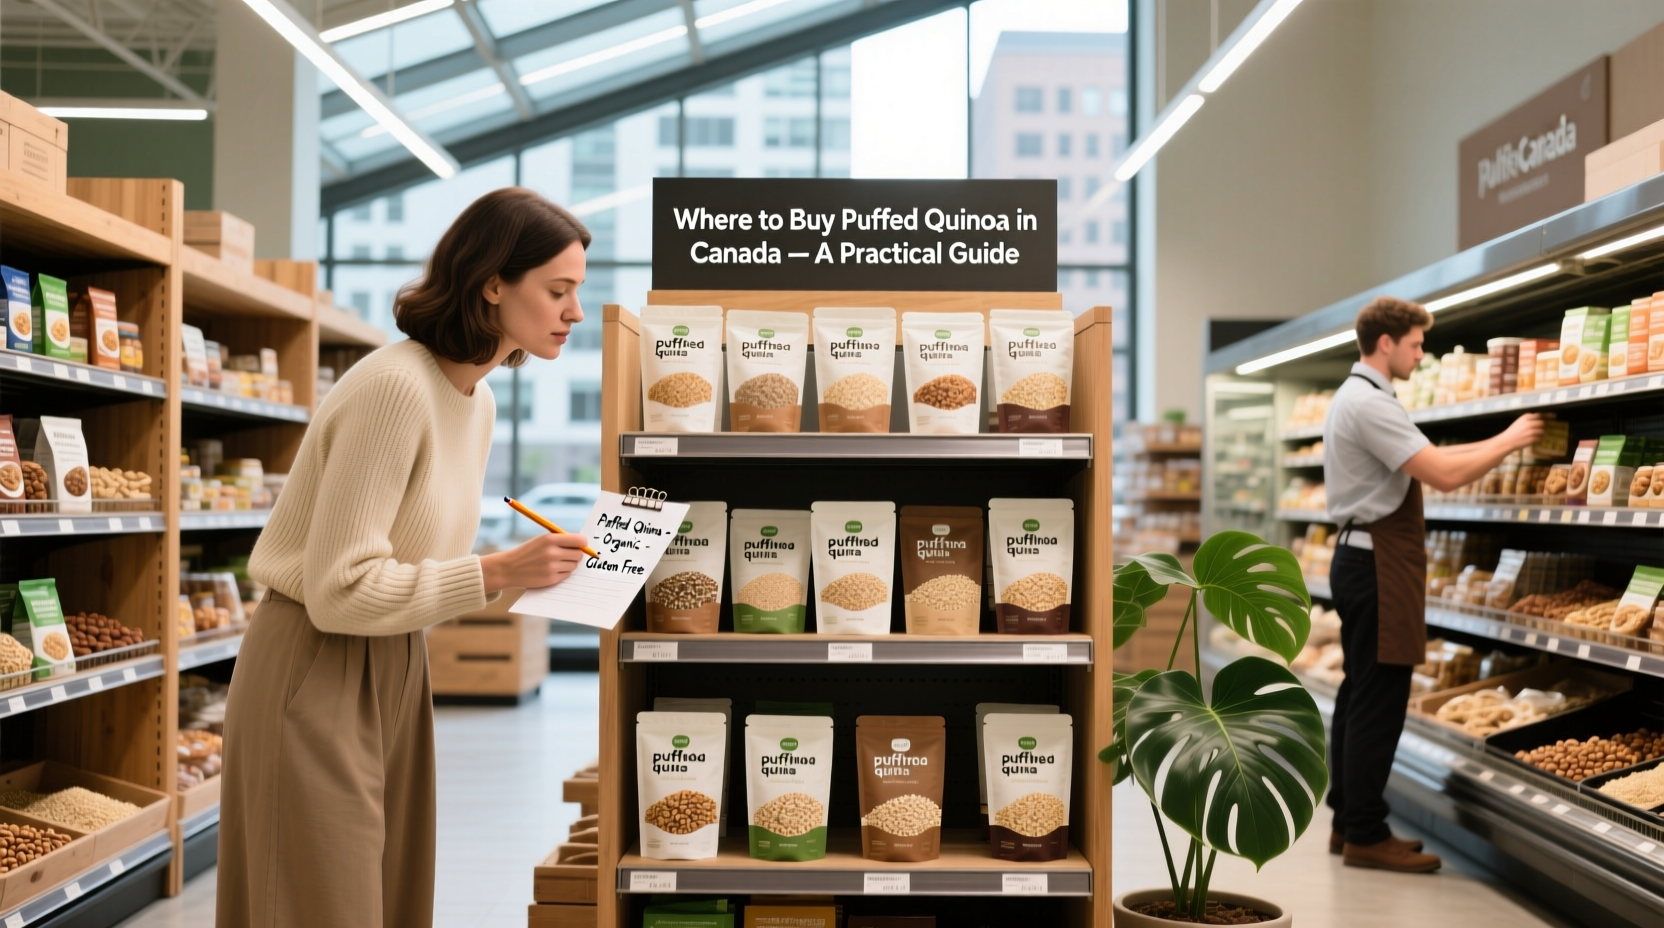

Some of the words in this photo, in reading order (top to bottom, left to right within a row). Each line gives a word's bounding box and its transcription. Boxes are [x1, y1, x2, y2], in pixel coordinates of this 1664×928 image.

[673, 207, 753, 231] Where
[757, 209, 784, 231] to
[790, 208, 836, 237] Buy
[842, 207, 919, 231] Puffed
[924, 208, 1010, 233] Quinoa
[1016, 207, 1038, 231] in
[690, 240, 782, 264] Canada
[814, 241, 835, 264] A
[840, 241, 942, 264] Practical
[948, 241, 1020, 264] Guide
